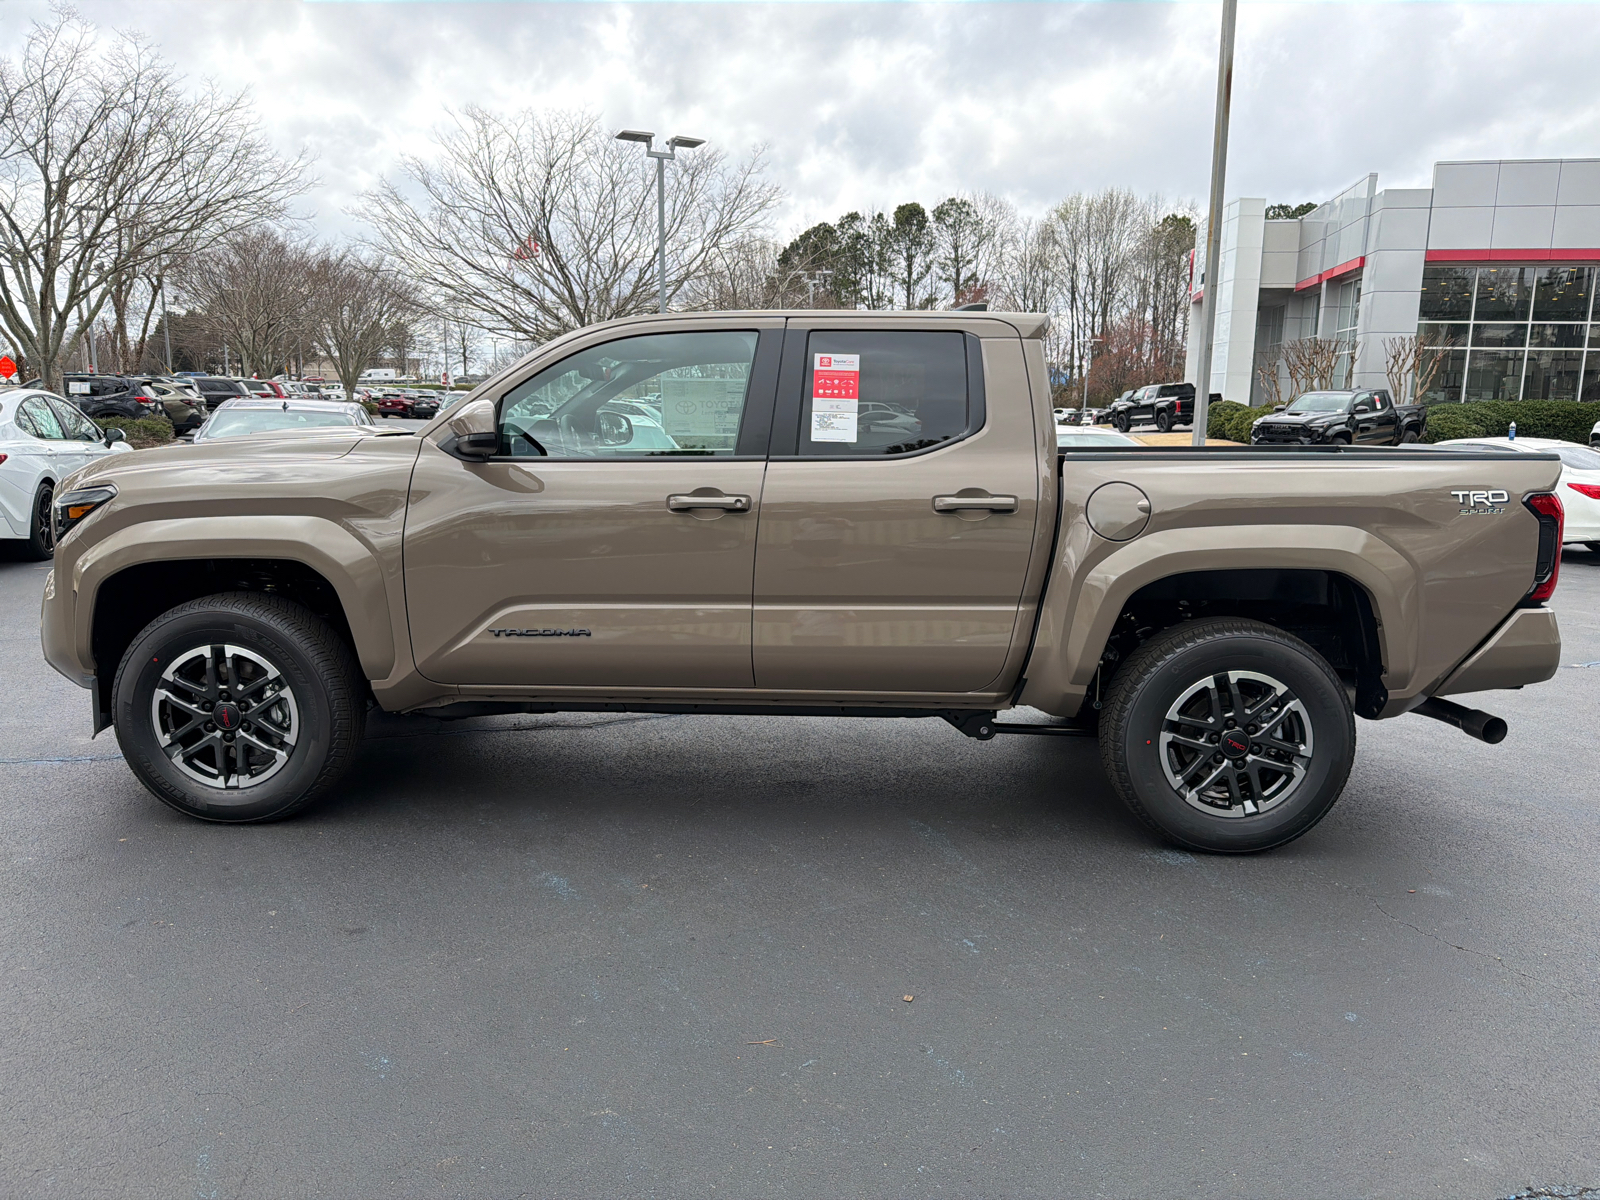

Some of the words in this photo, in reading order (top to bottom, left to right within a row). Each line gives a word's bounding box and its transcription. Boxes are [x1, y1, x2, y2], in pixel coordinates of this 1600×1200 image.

[1450, 490, 1510, 507] TRD
[488, 628, 592, 637] TACOMA
[260, 637, 309, 685] MICHELIN
[222, 707, 230, 727] TRD
[1227, 738, 1246, 750] TRD
